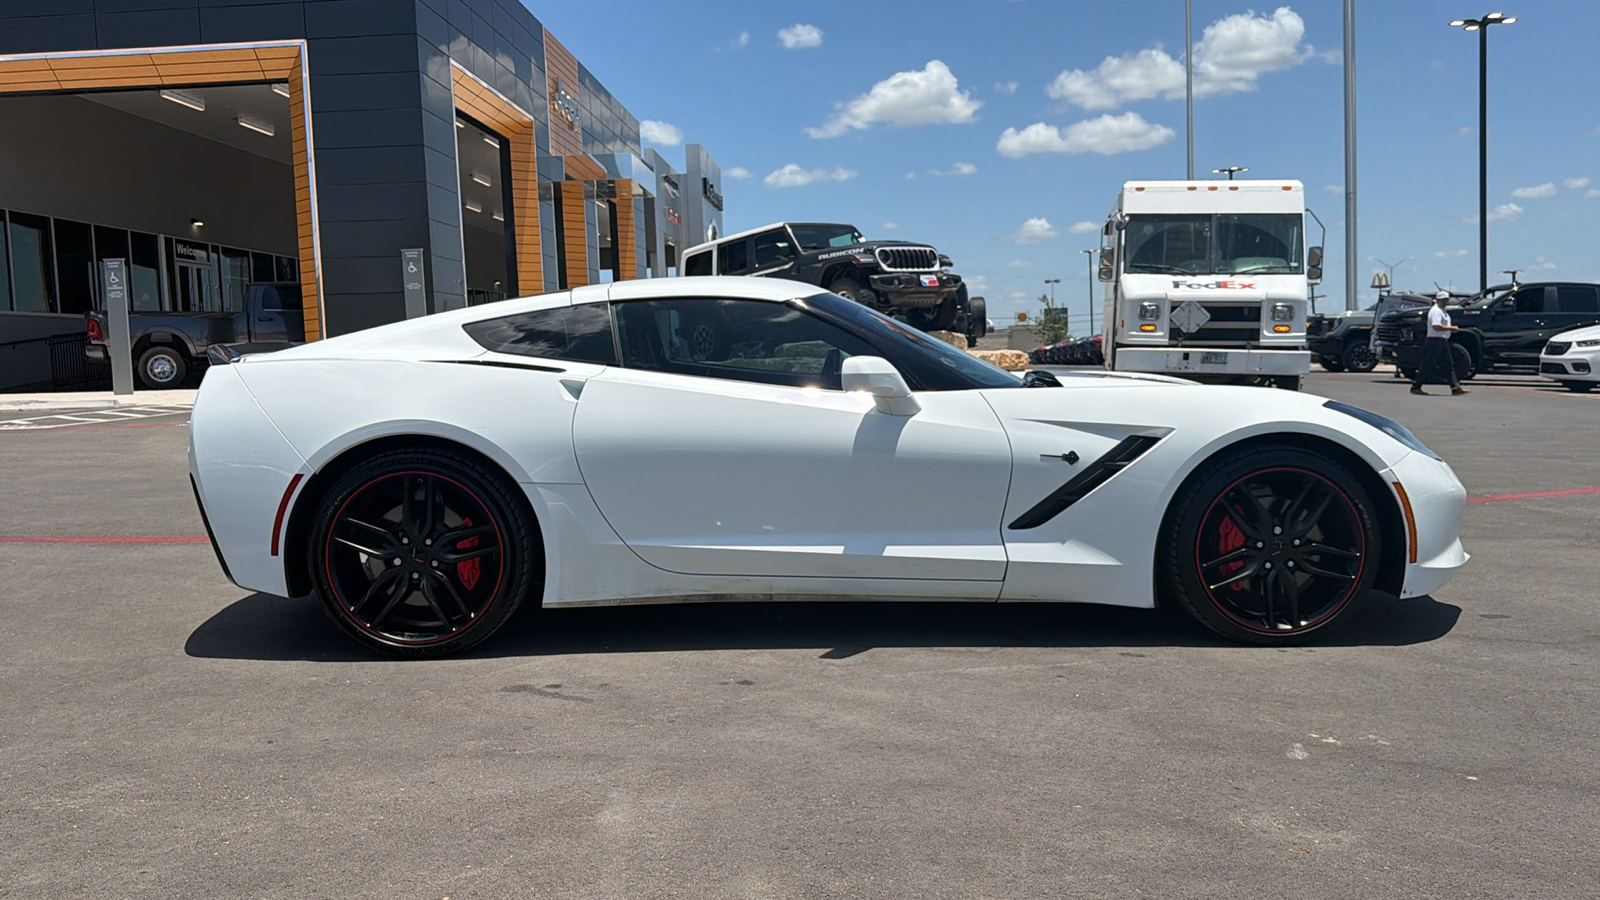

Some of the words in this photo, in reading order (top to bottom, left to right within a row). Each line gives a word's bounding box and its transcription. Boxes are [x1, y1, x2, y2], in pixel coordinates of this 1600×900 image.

[177, 243, 206, 257] Welcome
[818, 248, 864, 260] RUBICON
[1172, 280, 1257, 289] FedEx
